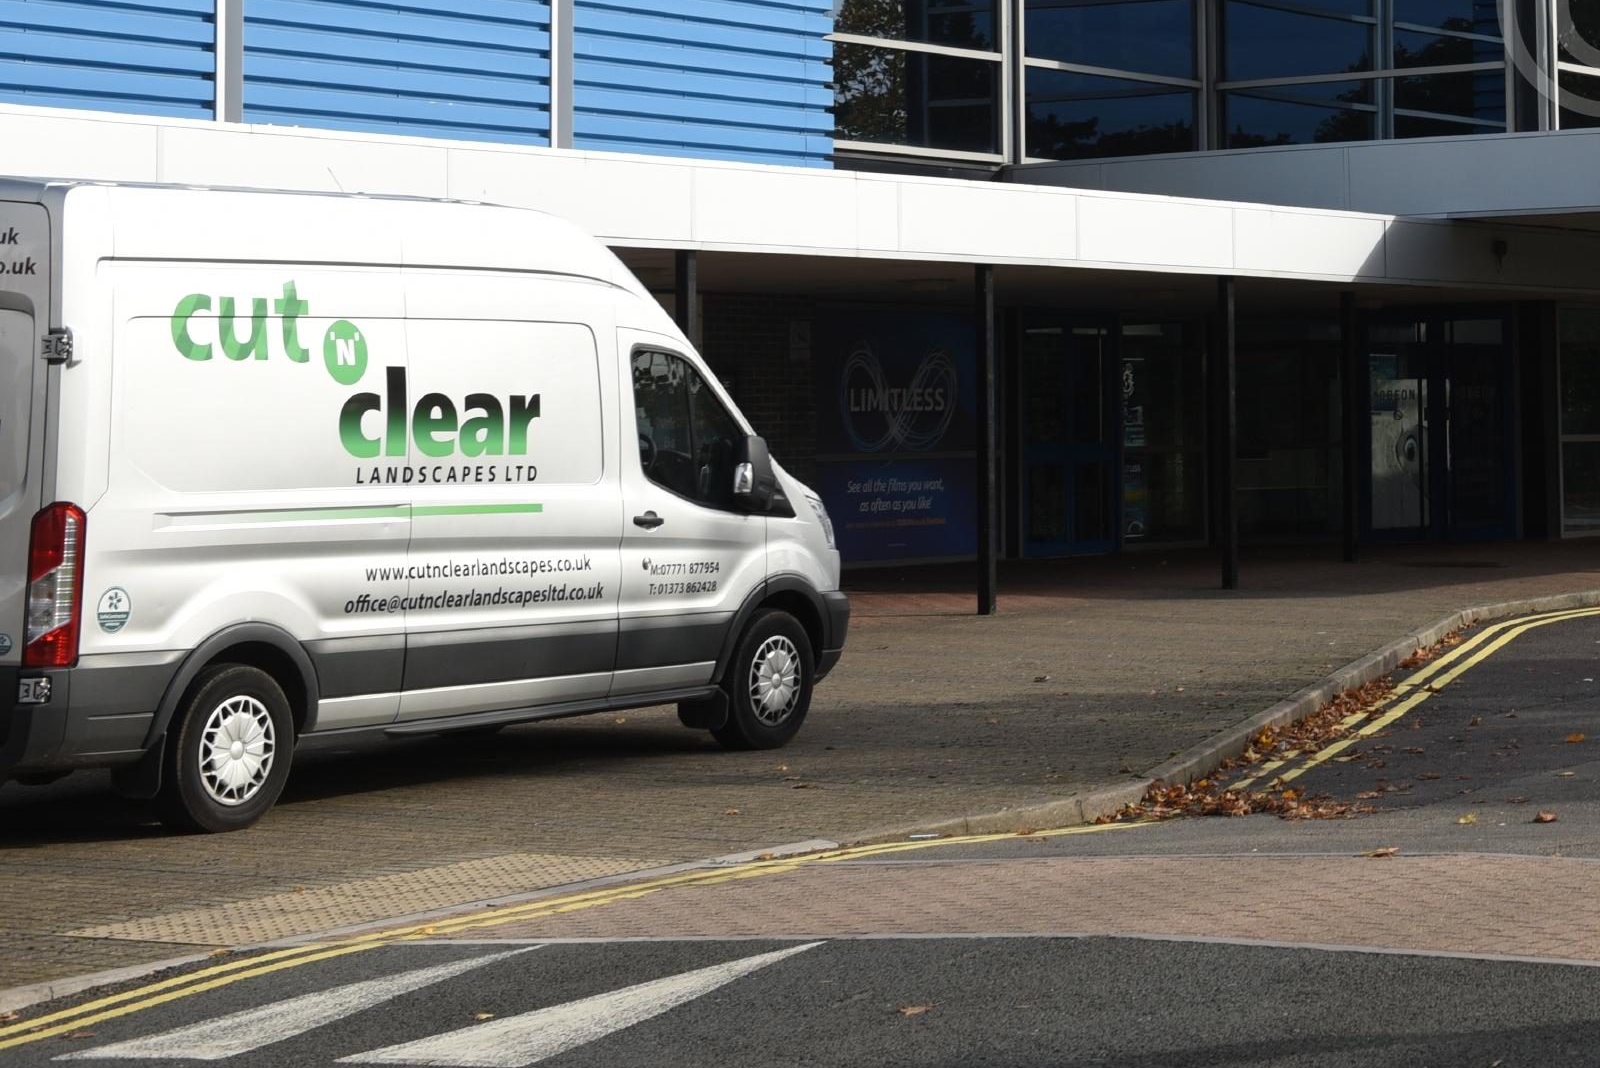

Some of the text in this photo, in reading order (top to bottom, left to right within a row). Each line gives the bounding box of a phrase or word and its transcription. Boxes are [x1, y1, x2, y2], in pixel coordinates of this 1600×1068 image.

[171, 279, 310, 363] cut
[850, 387, 945, 412] LIMITLESS
[339, 366, 541, 459] clear
[356, 465, 539, 484] LANDSCAPES LTD
[848, 480, 861, 493] See
[874, 479, 887, 492] the
[887, 478, 907, 494] films
[907, 481, 922, 494] you
[871, 499, 891, 514] often
[901, 500, 917, 513] you
[366, 554, 592, 582] www.cutnclearlandscapes.co.uk
[689, 562, 720, 573] 877954
[344, 582, 604, 614] office@cutnclearlandscapesltd.co.uk
[649, 580, 717, 595] T: 01373 862428
